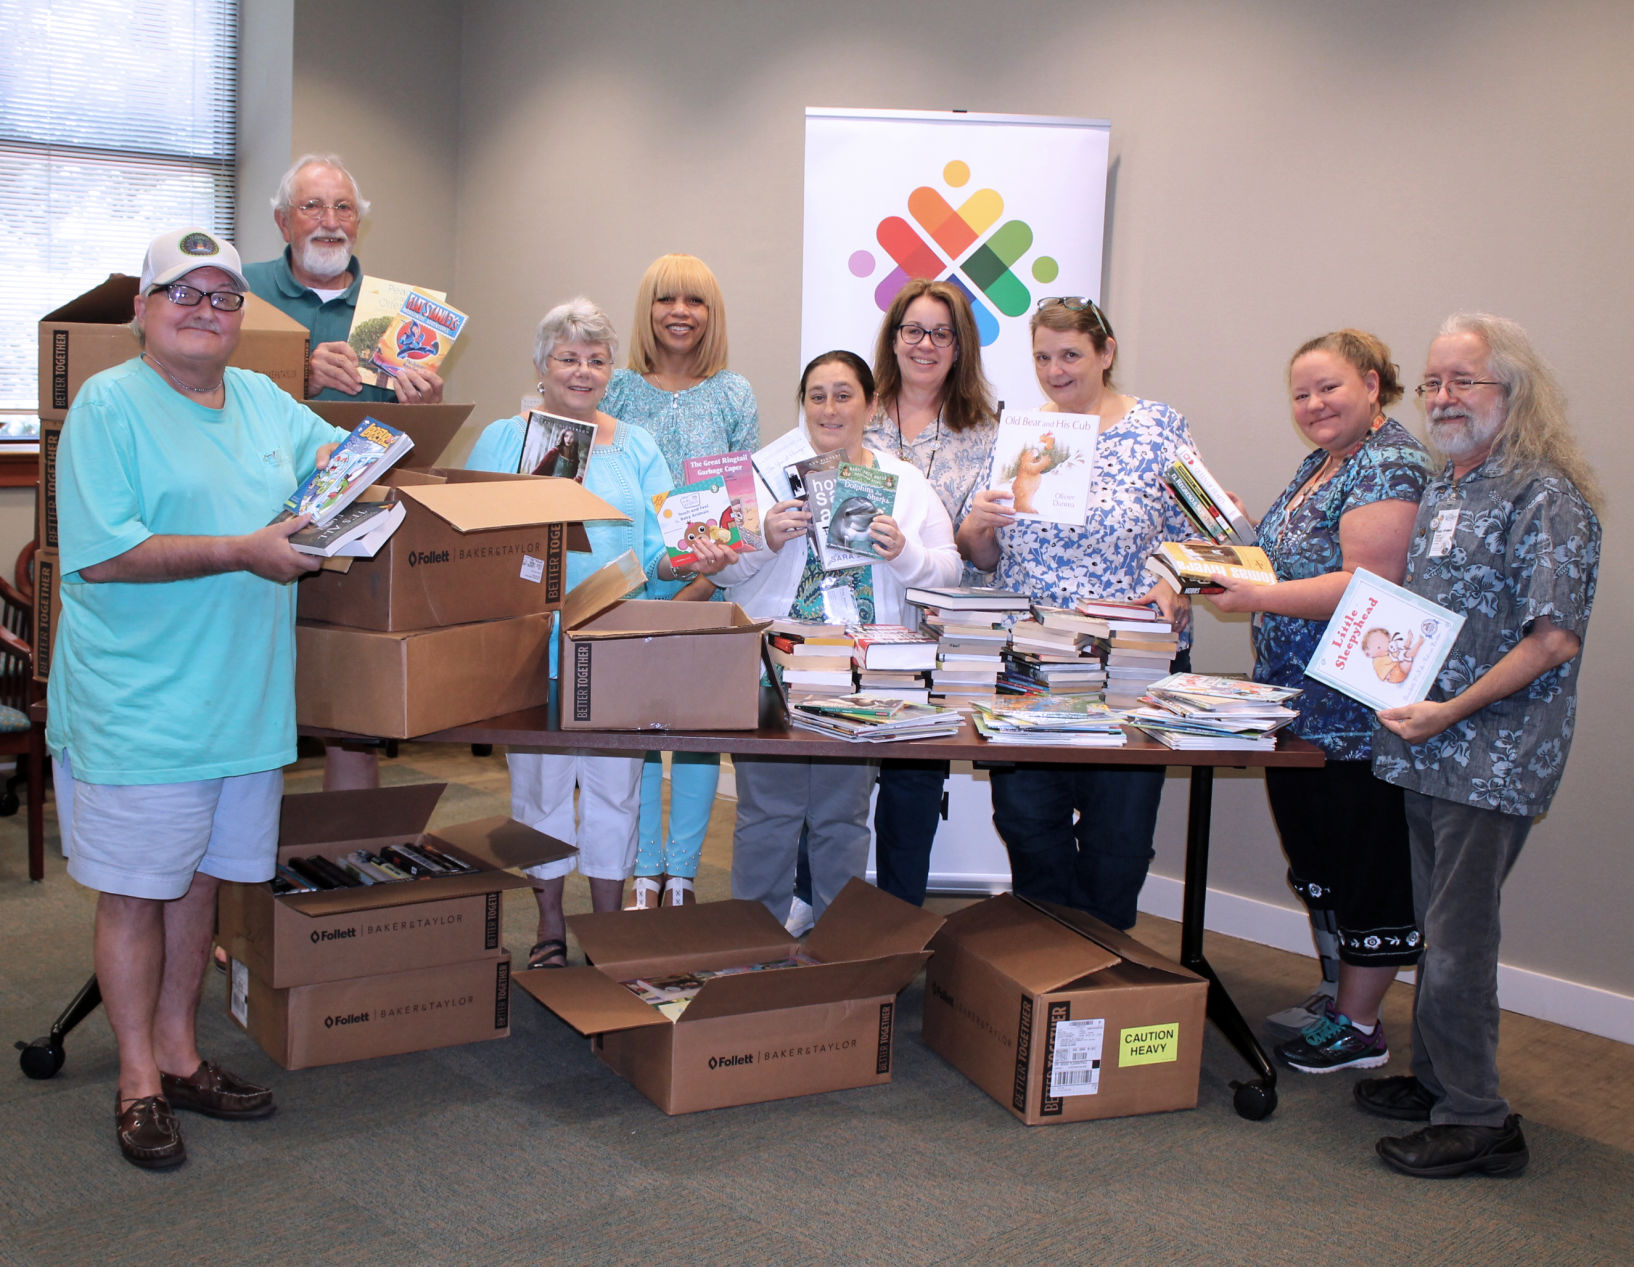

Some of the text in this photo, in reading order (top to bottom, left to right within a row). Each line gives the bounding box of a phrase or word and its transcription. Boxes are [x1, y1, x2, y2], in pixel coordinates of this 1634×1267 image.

[55, 334, 67, 406] BETTER TOGETHER
[1005, 416, 1091, 431] Old Bear and His Cub
[703, 459, 721, 467] Great
[722, 454, 748, 464] Ringtail
[697, 465, 743, 476] Garbage Caper
[813, 479, 836, 493] ho
[844, 481, 874, 494] Dolphins
[866, 493, 891, 505] Sharks
[418, 550, 450, 566] Follett
[548, 523, 561, 599] BETTER TOGE
[41, 567, 51, 627] TOGETHER
[1332, 610, 1358, 648] Little
[1336, 597, 1379, 670] Sleepyhead
[576, 646, 589, 719] BETTER TOGETHER
[321, 927, 357, 941] Follett
[335, 1012, 370, 1026] Follett
[1124, 1029, 1174, 1044] CAUTION
[1014, 1001, 1032, 1108] BETTER TOGETHER
[1130, 1044, 1167, 1057] HEAVY
[719, 1053, 753, 1068] Follett
